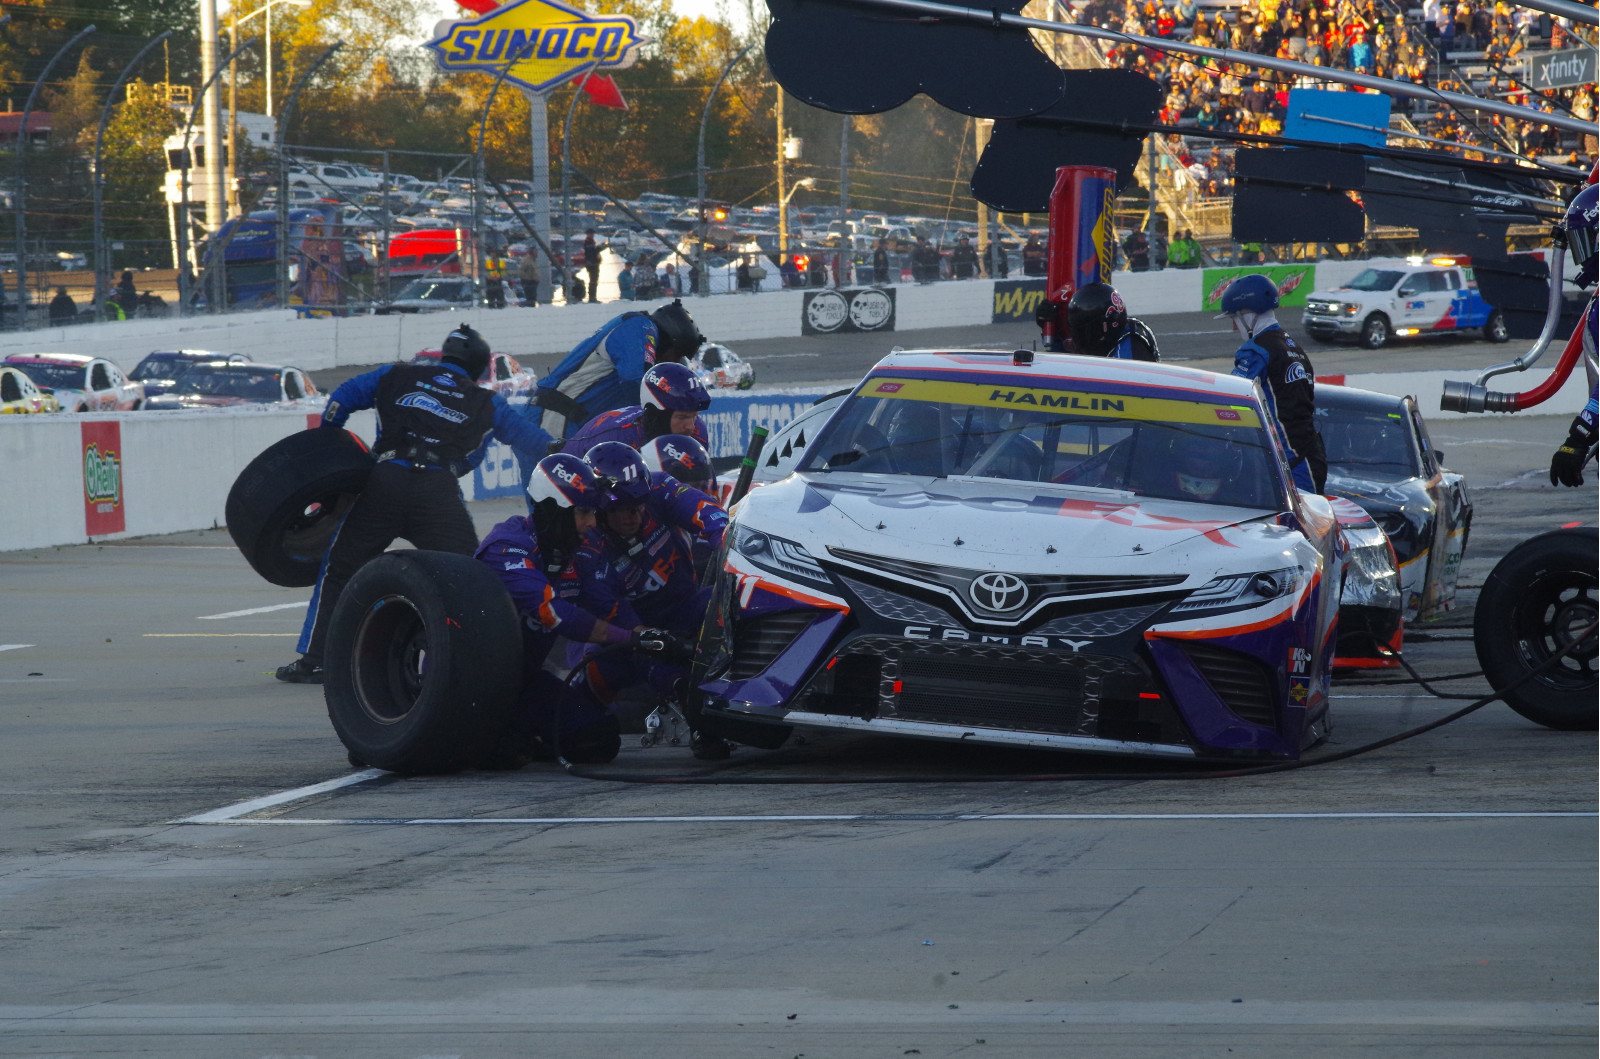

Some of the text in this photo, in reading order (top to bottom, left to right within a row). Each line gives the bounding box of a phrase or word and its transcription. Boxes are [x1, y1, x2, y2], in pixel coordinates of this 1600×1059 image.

[448, 27, 625, 61] SUNOCO
[1540, 54, 1587, 85] xfinity
[1101, 187, 1115, 285] SUNOCO
[645, 368, 672, 394] FedEx
[688, 377, 701, 389] 11
[989, 389, 1125, 412] HAMLIN
[662, 442, 696, 470] FedEx
[552, 462, 588, 493] FedEx
[622, 463, 637, 482] 11
[797, 481, 1241, 548] FedEx
[903, 626, 1096, 653] CAMRY
